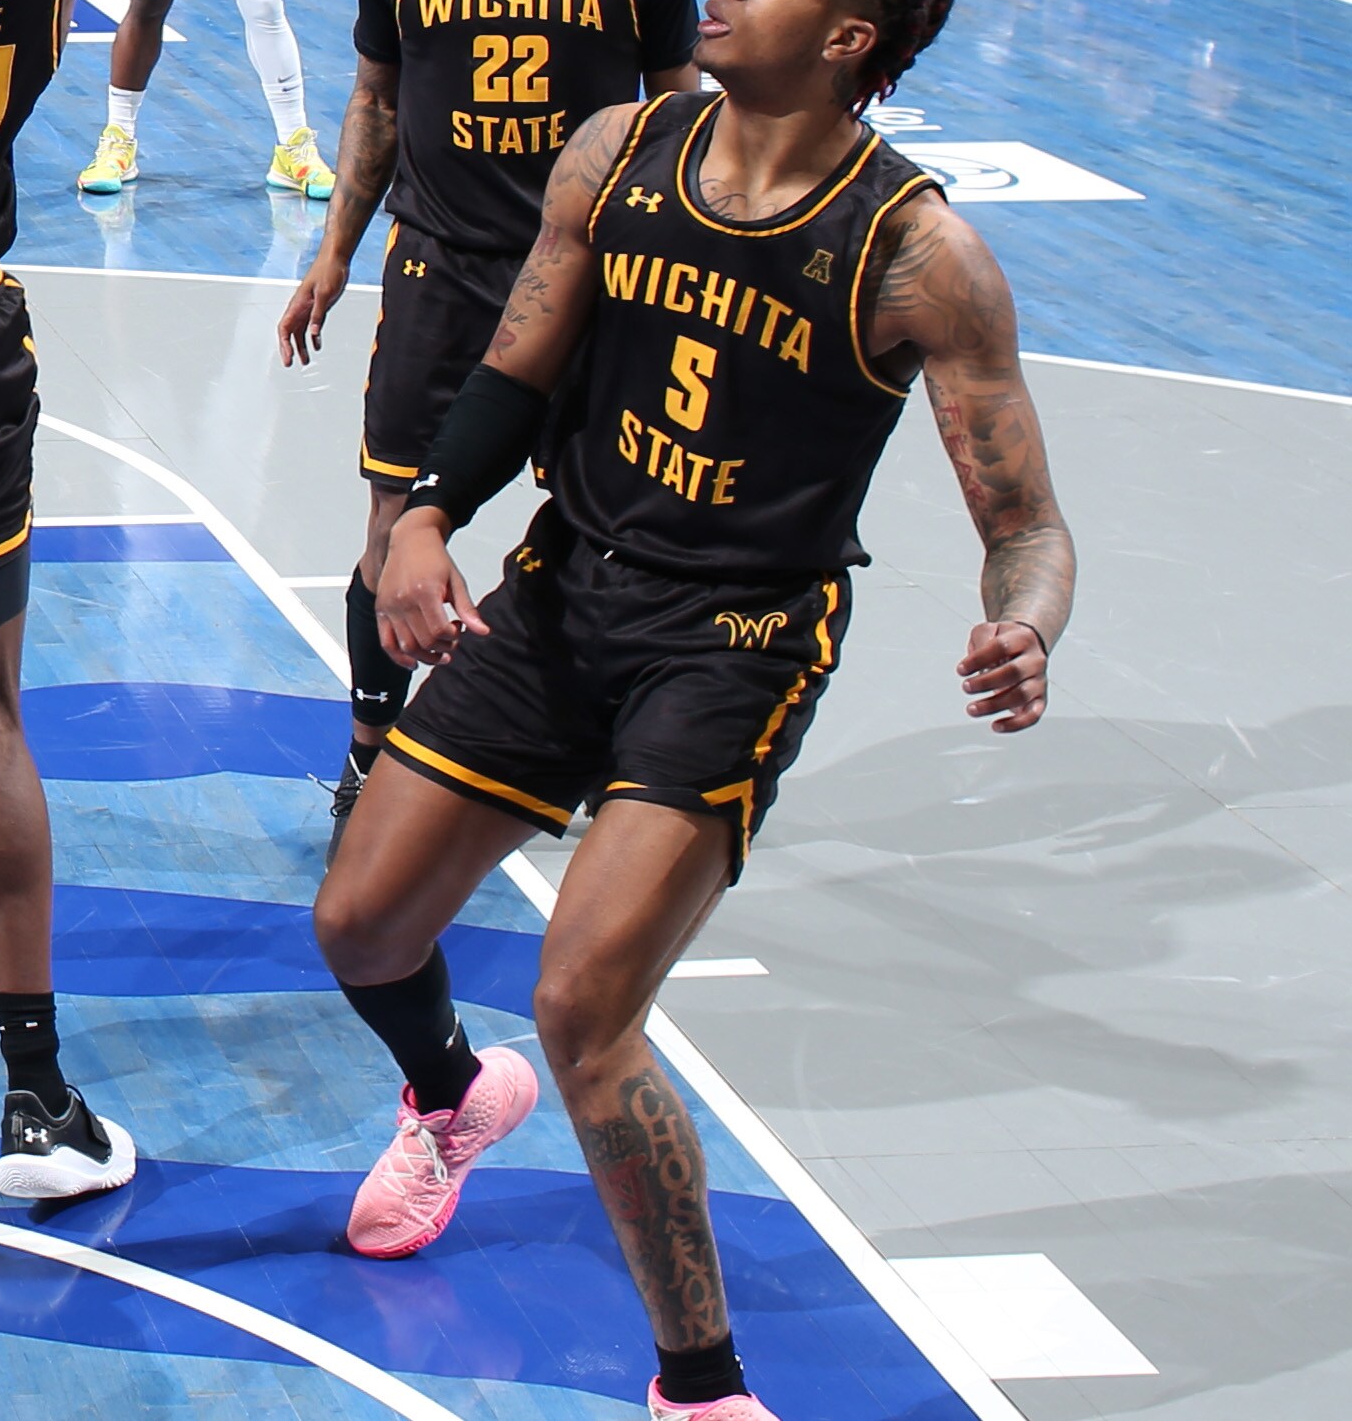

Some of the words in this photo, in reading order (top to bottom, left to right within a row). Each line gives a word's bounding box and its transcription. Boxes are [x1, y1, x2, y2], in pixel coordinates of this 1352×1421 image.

[472, 34, 549, 103] 22
[451, 110, 566, 154] STATE
[603, 252, 813, 374] WICHITA
[664, 334, 718, 432] 5
[618, 409, 745, 505] STATE
